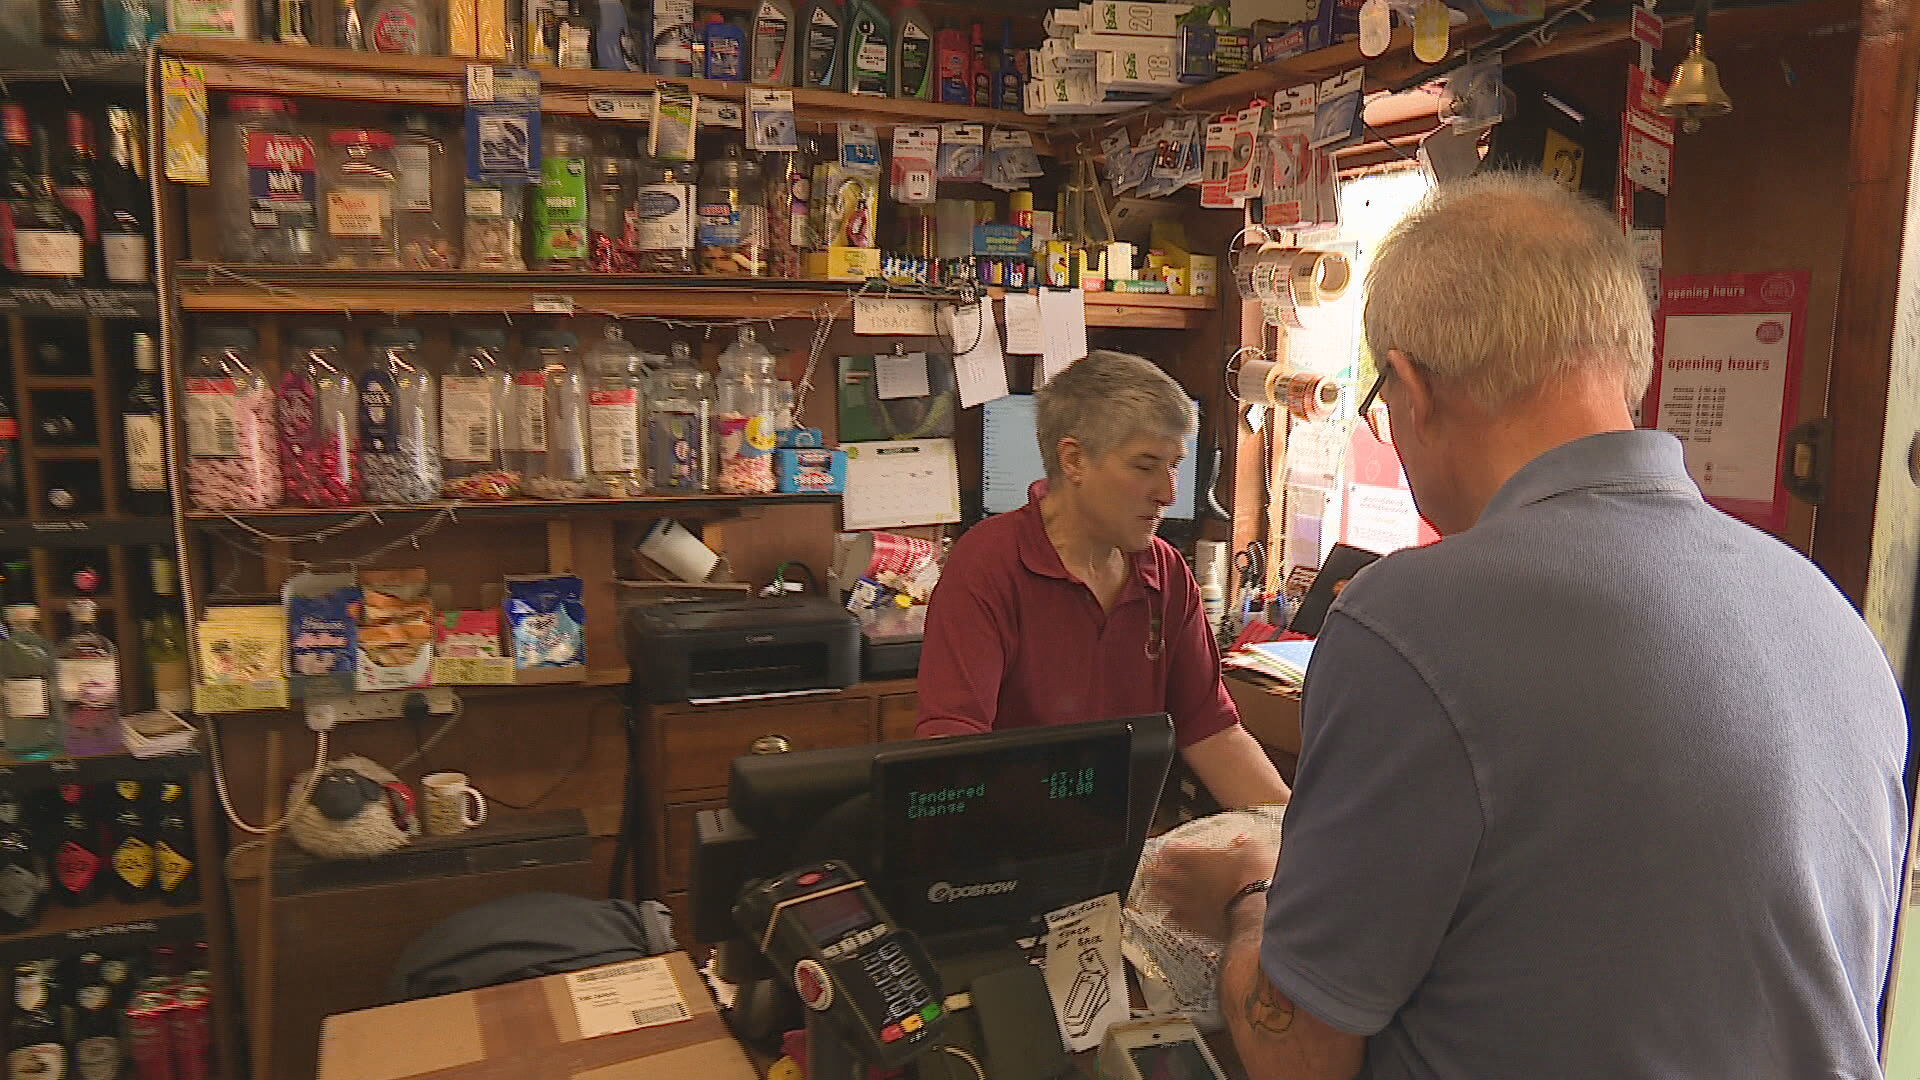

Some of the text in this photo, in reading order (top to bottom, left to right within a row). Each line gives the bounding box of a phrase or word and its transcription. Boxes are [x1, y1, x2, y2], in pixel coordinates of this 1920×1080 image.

[1128, 5, 1153, 32] 20
[1147, 54, 1172, 81] 18
[266, 140, 304, 167] ARMY
[268, 171, 304, 195] NAVY
[1667, 286, 1710, 301] opening
[1713, 284, 1745, 298] hours
[1667, 355, 1770, 373] opening hours
[363, 392, 393, 407] FOX'S
[792, 472, 835, 487] TREBOR
[908, 783, 986, 807] Tendered
[907, 800, 967, 819] Change
